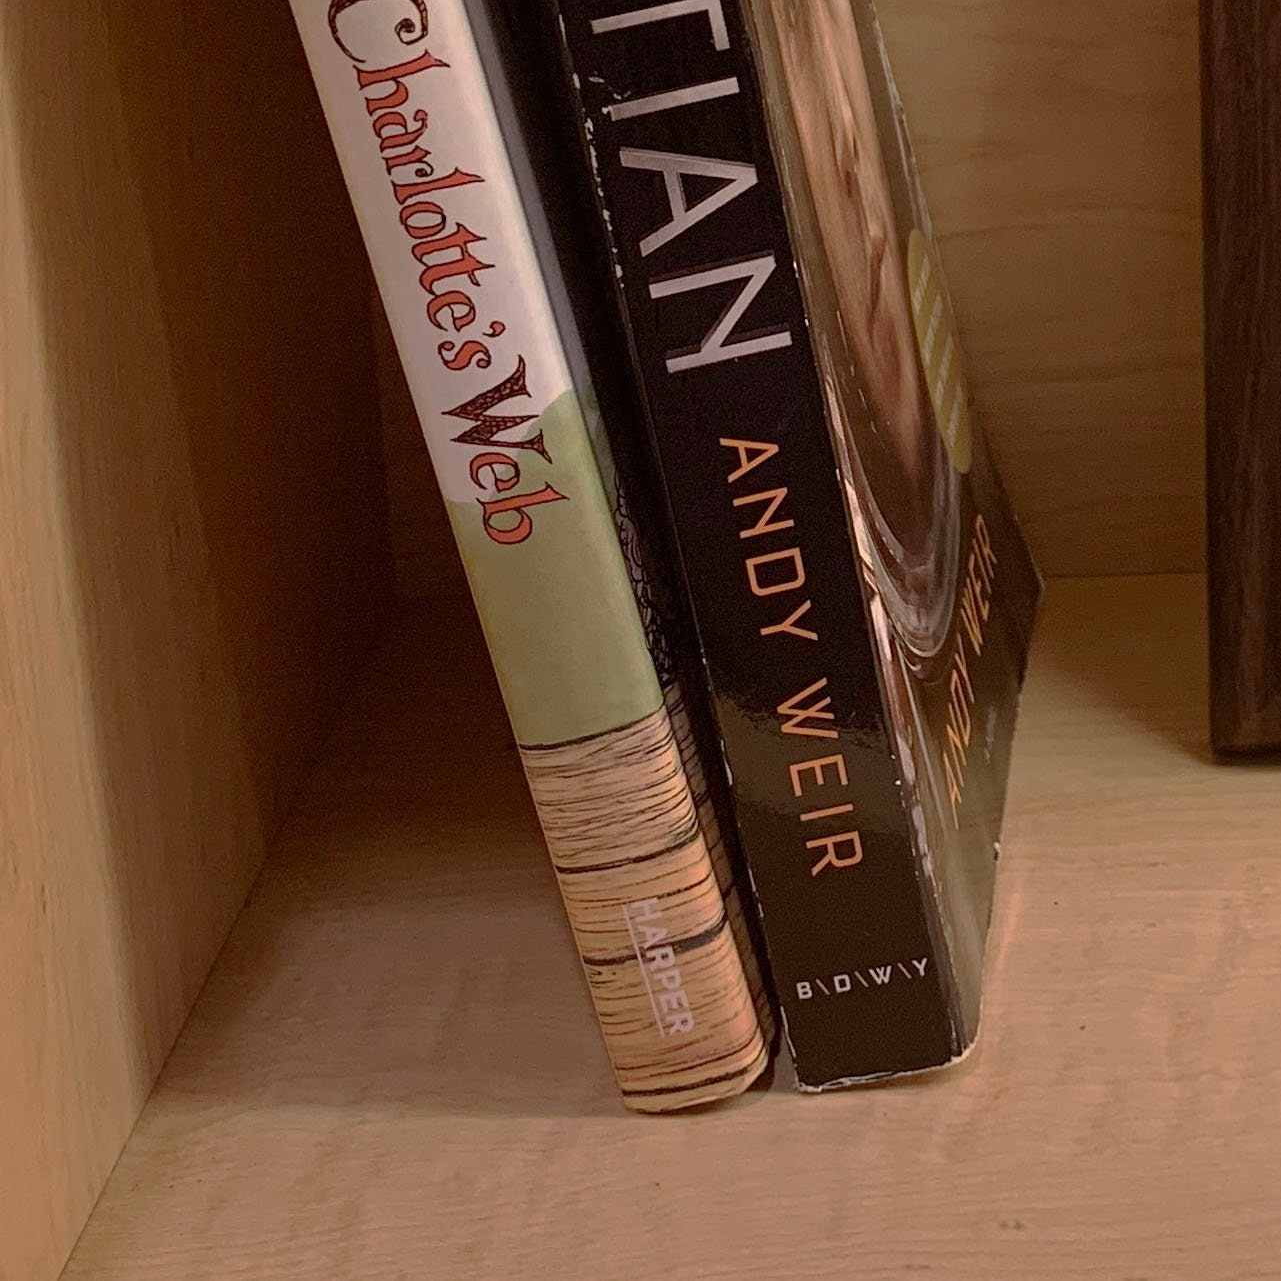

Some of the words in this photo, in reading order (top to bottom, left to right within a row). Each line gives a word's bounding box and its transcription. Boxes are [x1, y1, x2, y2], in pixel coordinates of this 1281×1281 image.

[441, 355, 570, 546] Web
[719, 437, 819, 642] ANDY
[776, 676, 864, 877] WEIR
[943, 632, 975, 831] ANDY
[961, 514, 998, 657] WEIR
[630, 897, 696, 1036] HARPER
